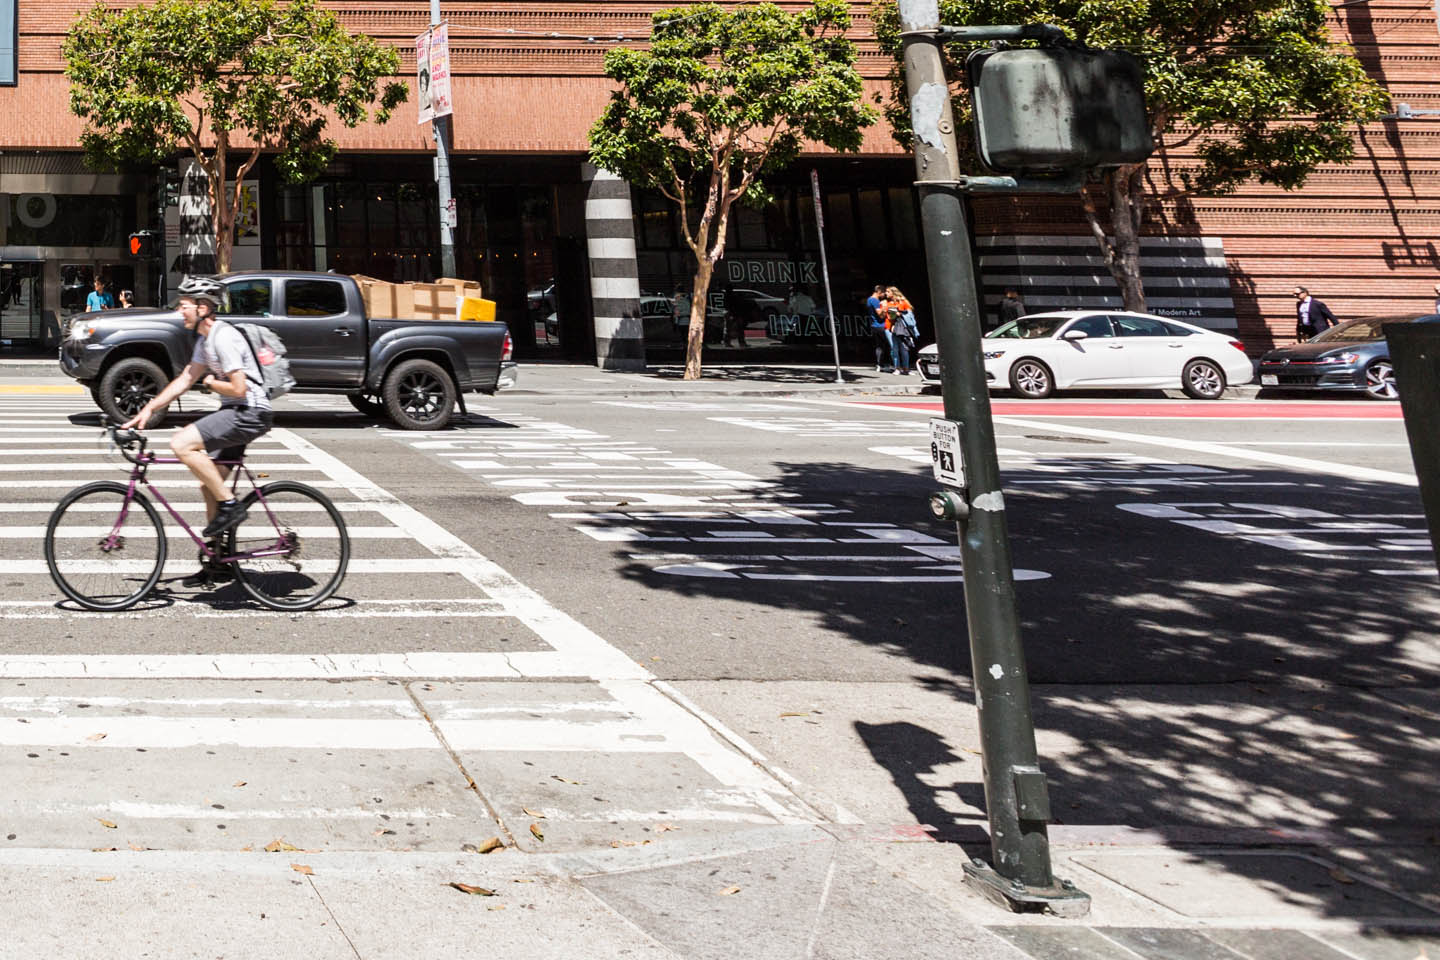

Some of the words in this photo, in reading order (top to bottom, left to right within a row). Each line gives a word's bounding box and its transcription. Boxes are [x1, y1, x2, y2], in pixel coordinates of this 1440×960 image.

[728, 260, 819, 284] DRINK
[1157, 308, 1188, 316] Modern
[1188, 308, 1201, 316] Art
[768, 314, 872, 337] IMAGIN
[935, 424, 951, 434] PUSH
[933, 431, 956, 443] BUTTON
[939, 440, 951, 449] FOR
